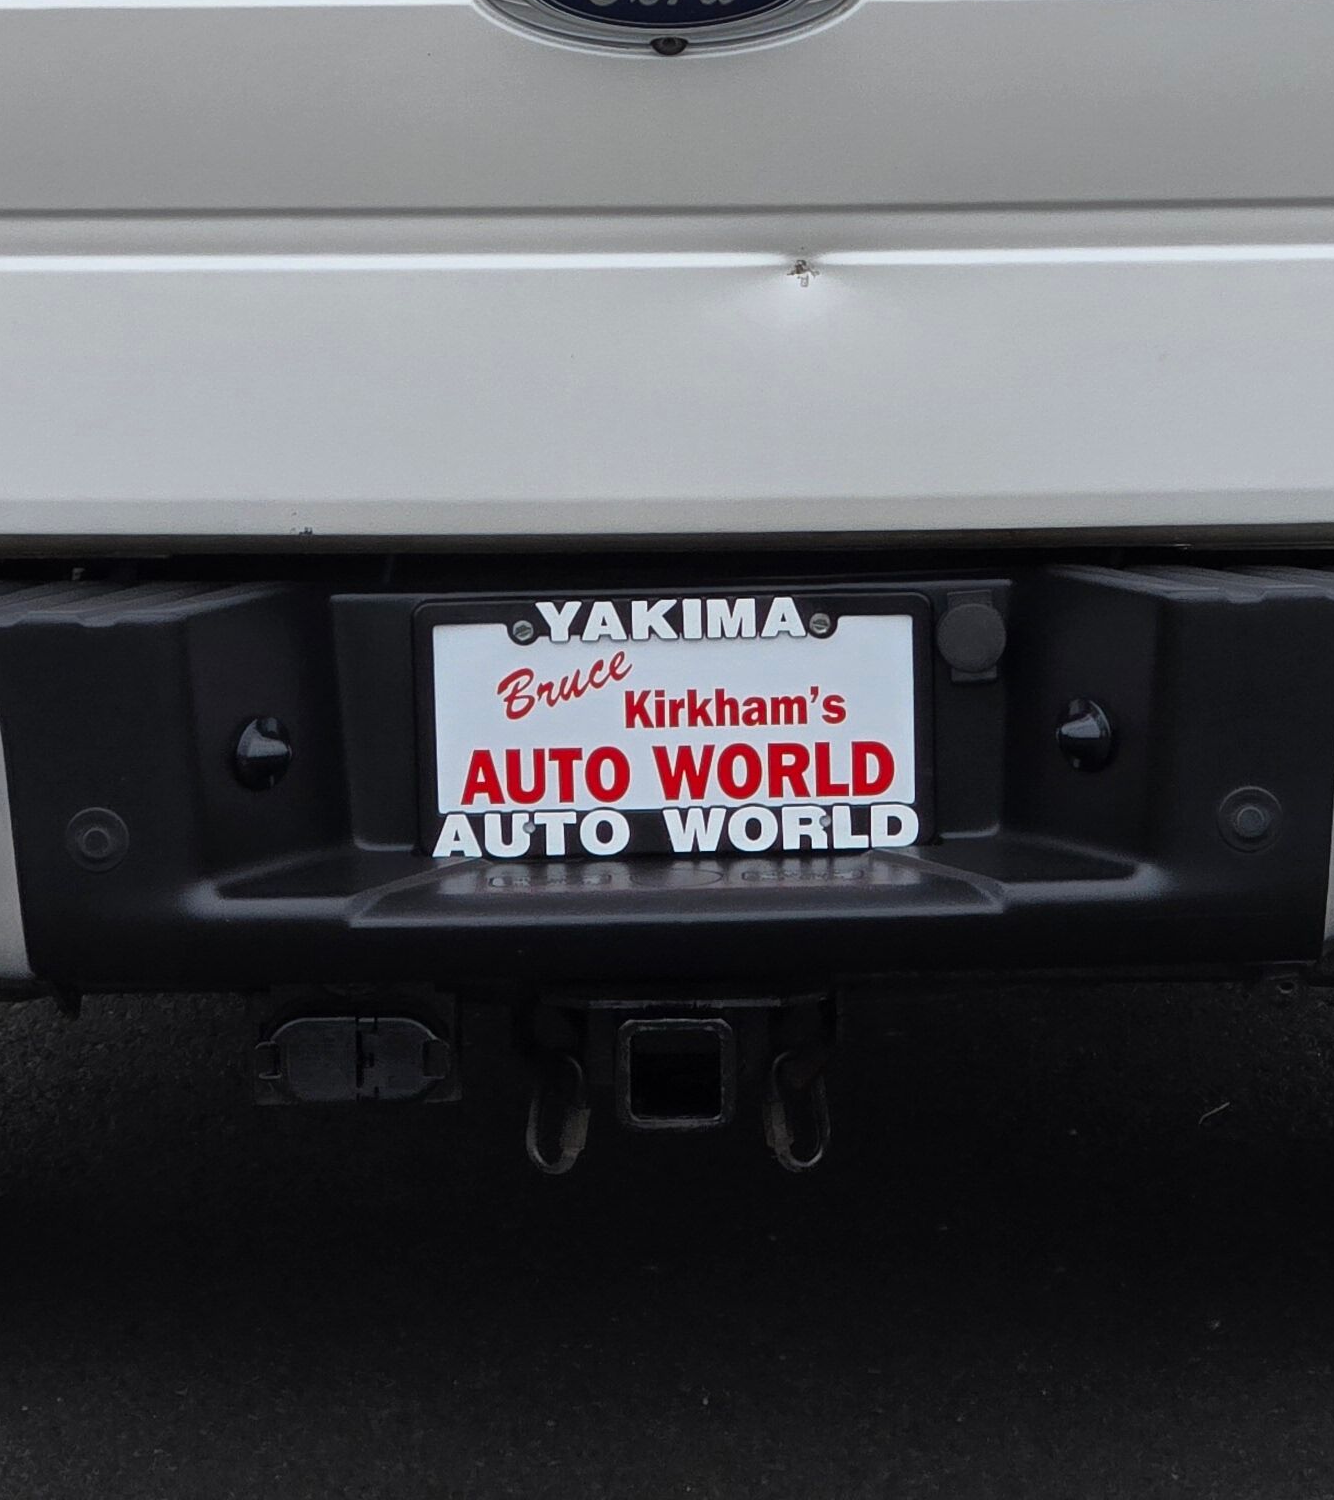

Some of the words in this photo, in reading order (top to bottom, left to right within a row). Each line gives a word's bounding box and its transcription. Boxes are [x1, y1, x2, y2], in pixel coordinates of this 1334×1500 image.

[535, 596, 806, 643] YAKIMA
[496, 650, 633, 721] Bruce
[624, 685, 847, 730] Kirkham's
[460, 746, 631, 806] AUTO
[652, 740, 896, 801] WORLD
[432, 808, 631, 859] AUTO
[662, 802, 920, 854] WORLD
